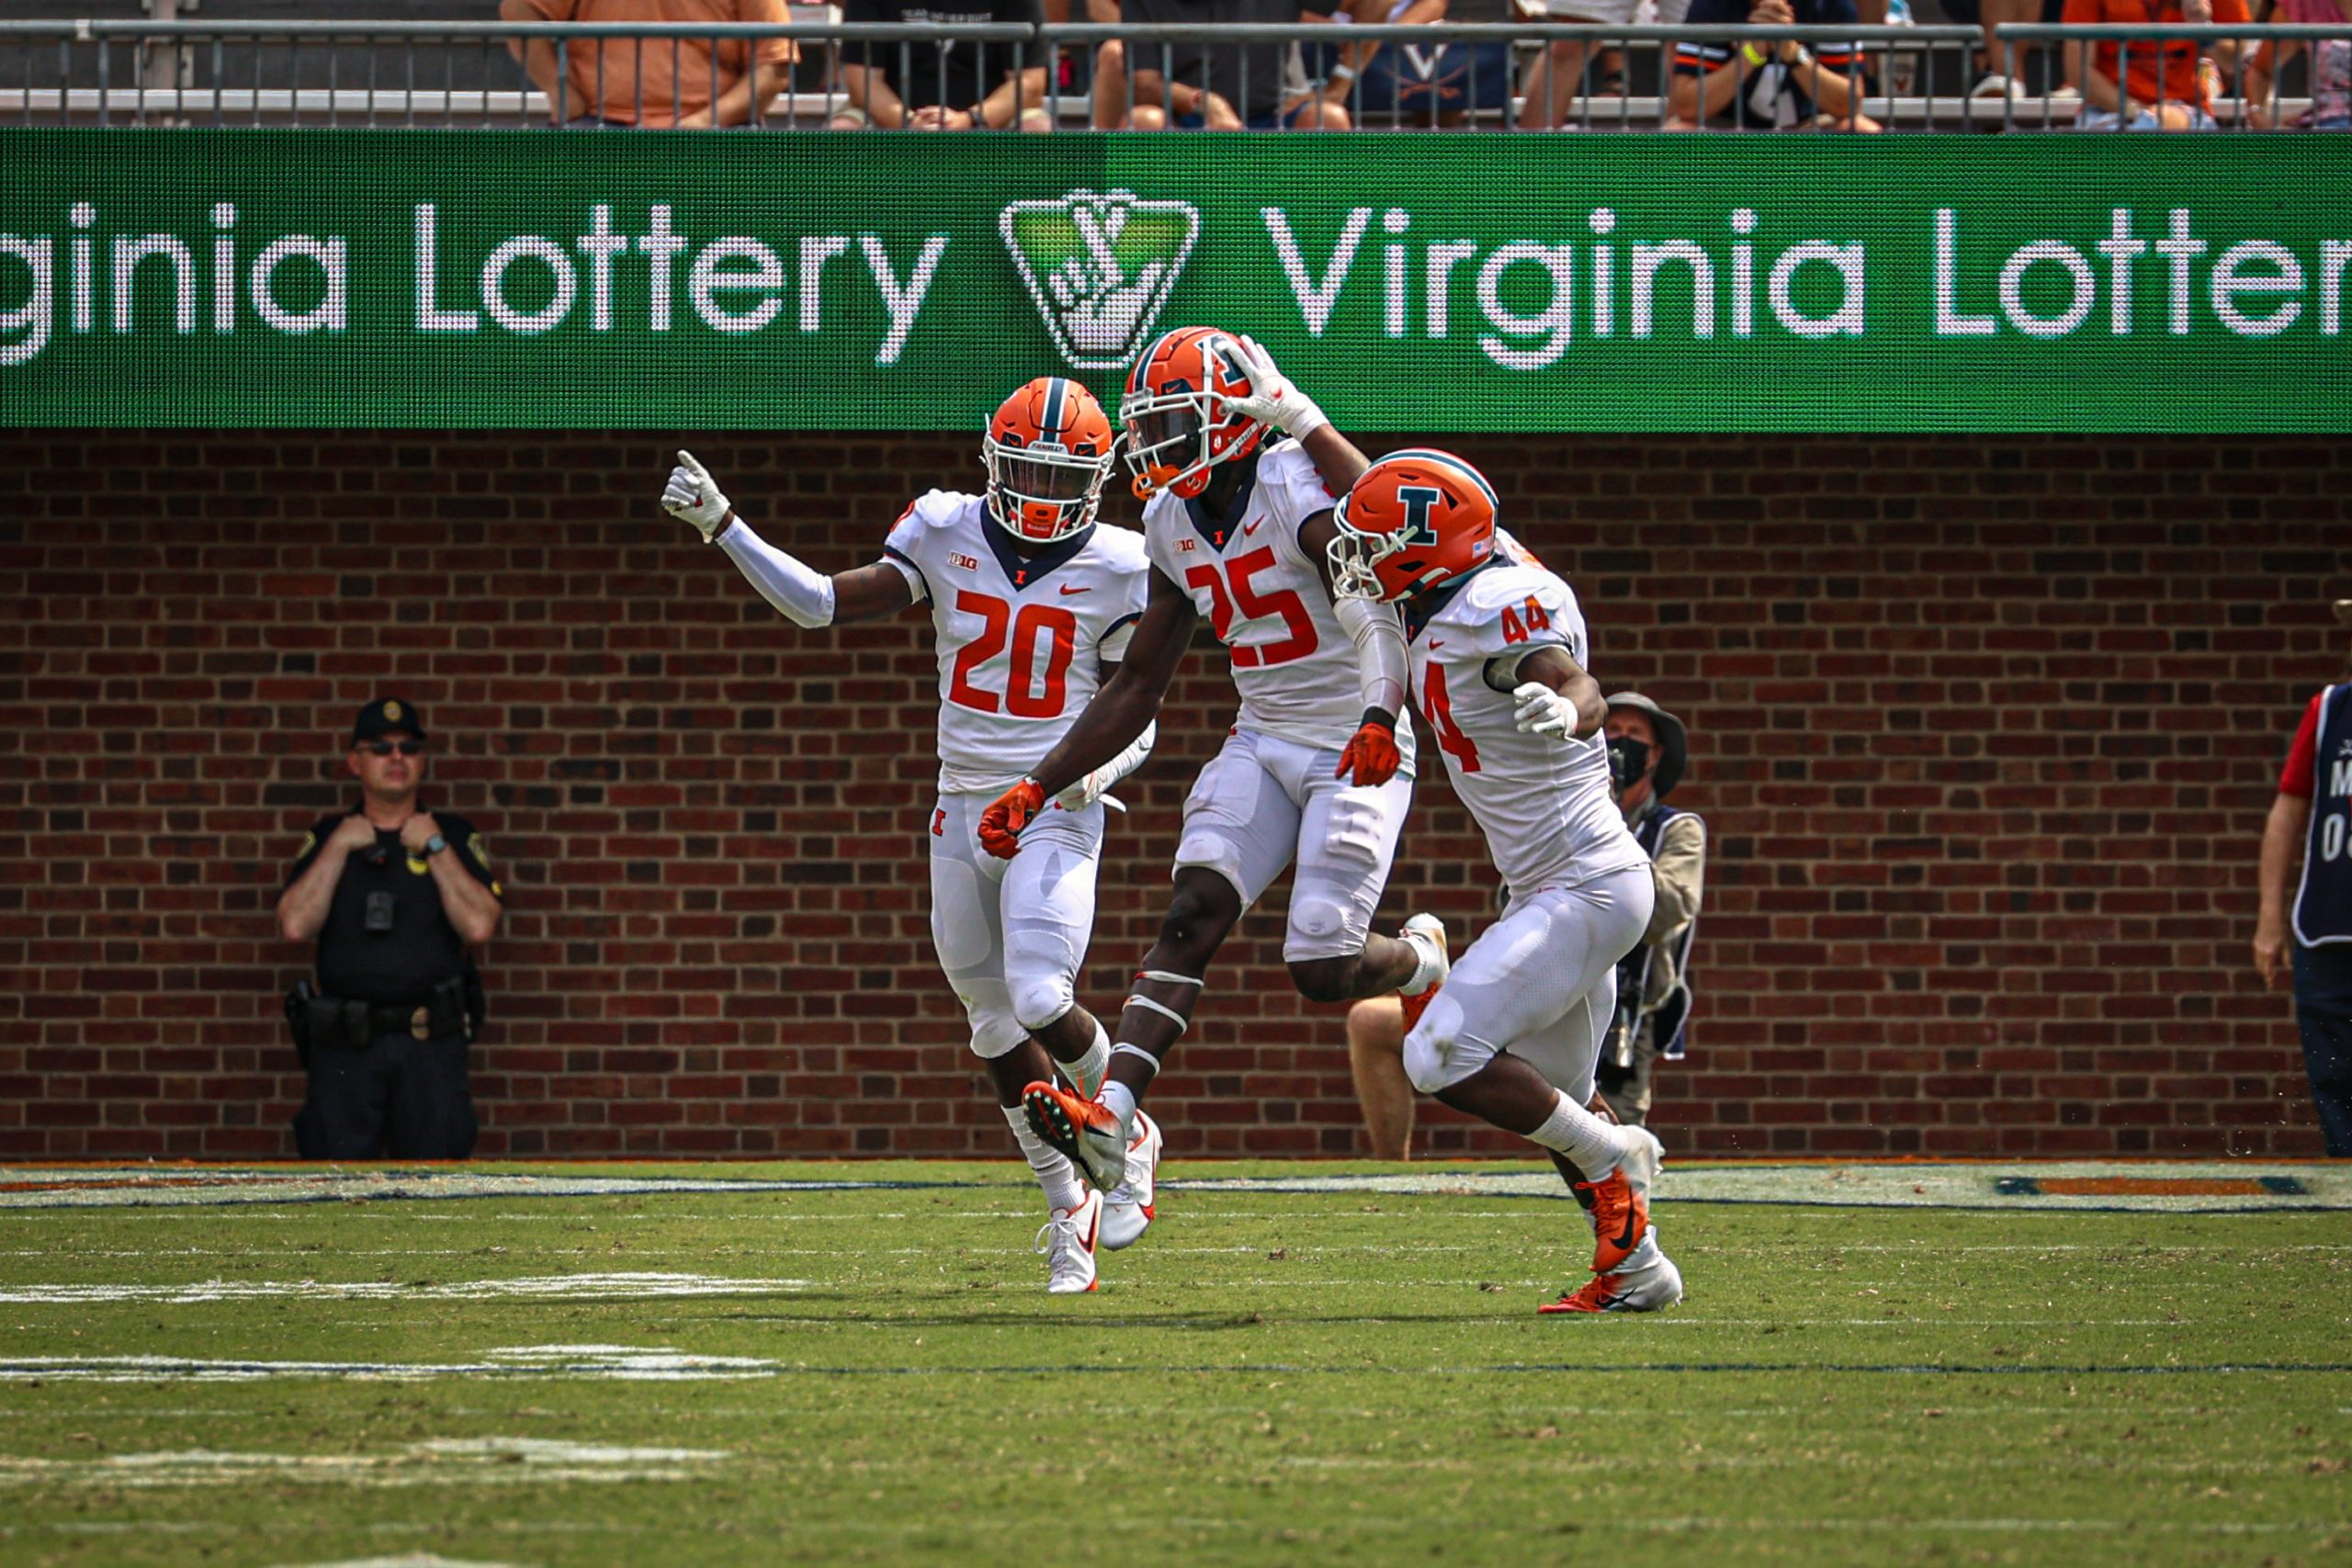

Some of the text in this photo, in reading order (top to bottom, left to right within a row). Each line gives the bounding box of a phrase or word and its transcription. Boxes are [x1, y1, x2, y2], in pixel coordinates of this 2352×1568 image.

[414, 201, 950, 367] Lottery
[1260, 206, 2352, 370] Virginia Lotter
[949, 590, 1076, 717] 20
[1185, 545, 1318, 667] 25
[1500, 594, 1552, 644] 44
